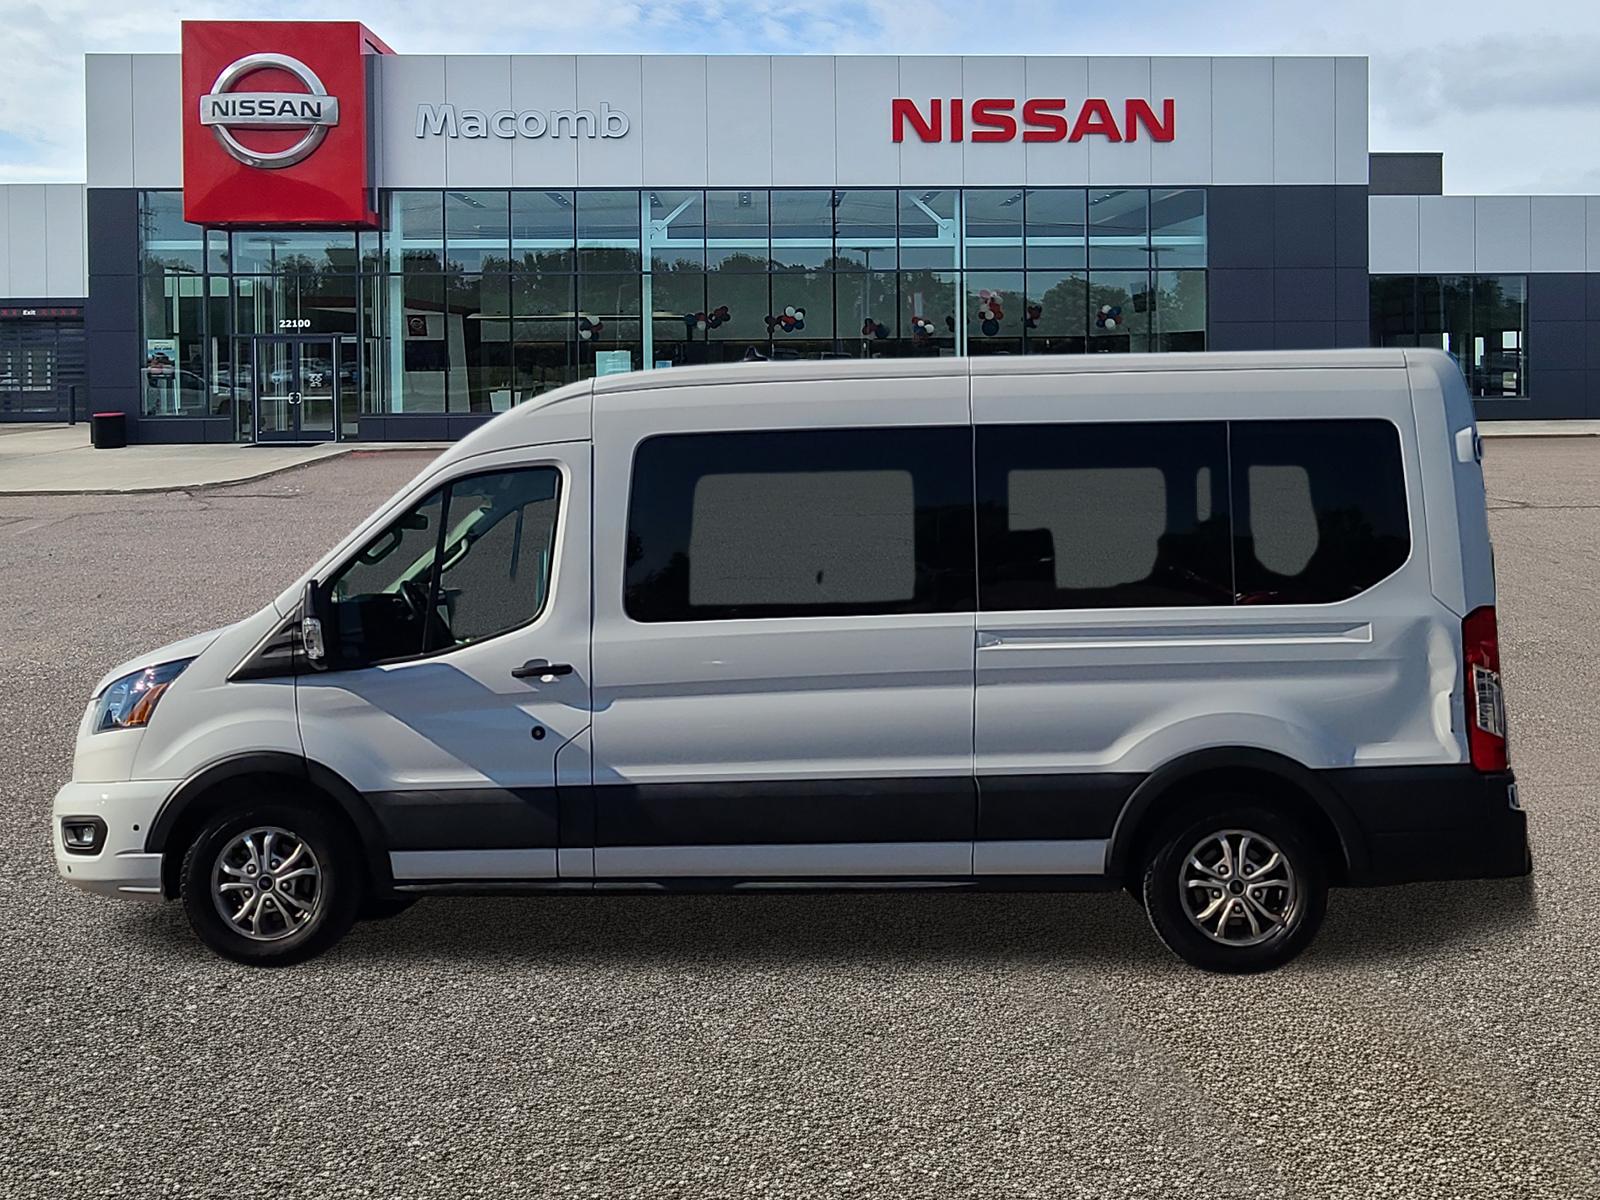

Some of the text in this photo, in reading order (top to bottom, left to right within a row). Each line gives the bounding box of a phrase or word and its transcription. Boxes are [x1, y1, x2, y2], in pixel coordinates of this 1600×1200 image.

[211, 99, 323, 119] NISSAN
[415, 101, 631, 139] Macomb
[891, 97, 1176, 143] NISSAN
[279, 319, 311, 328] 22100
